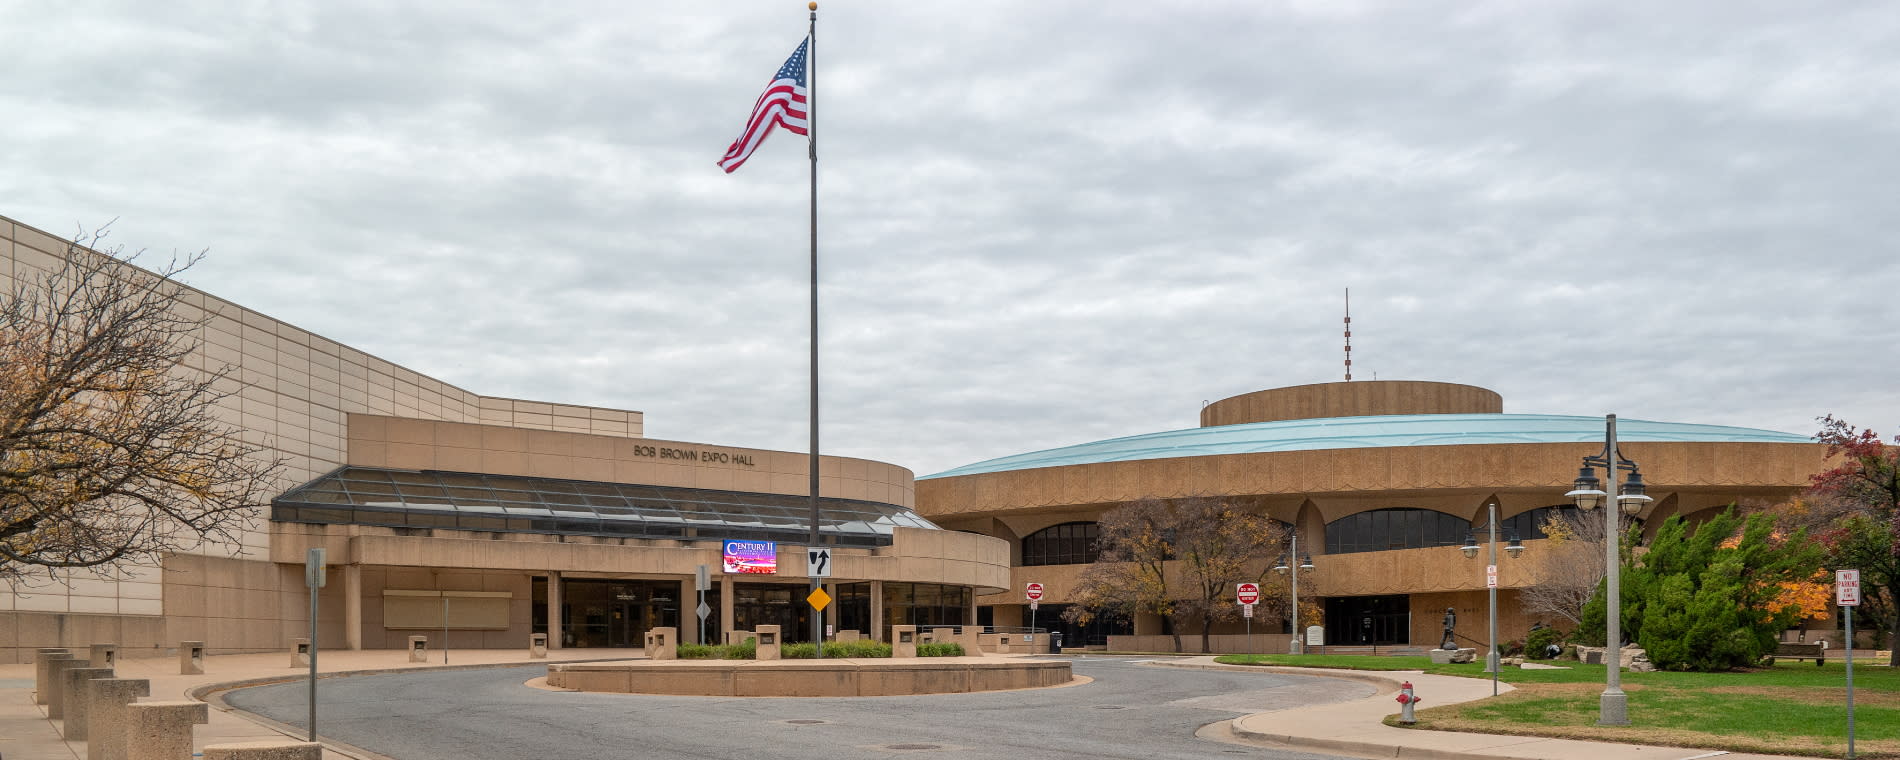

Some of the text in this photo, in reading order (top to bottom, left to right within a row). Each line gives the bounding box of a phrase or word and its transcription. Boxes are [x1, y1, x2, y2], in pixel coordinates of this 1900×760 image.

[634, 445, 755, 466] BOB BROWN EXPO HALL
[727, 542, 766, 555] CENTURY
